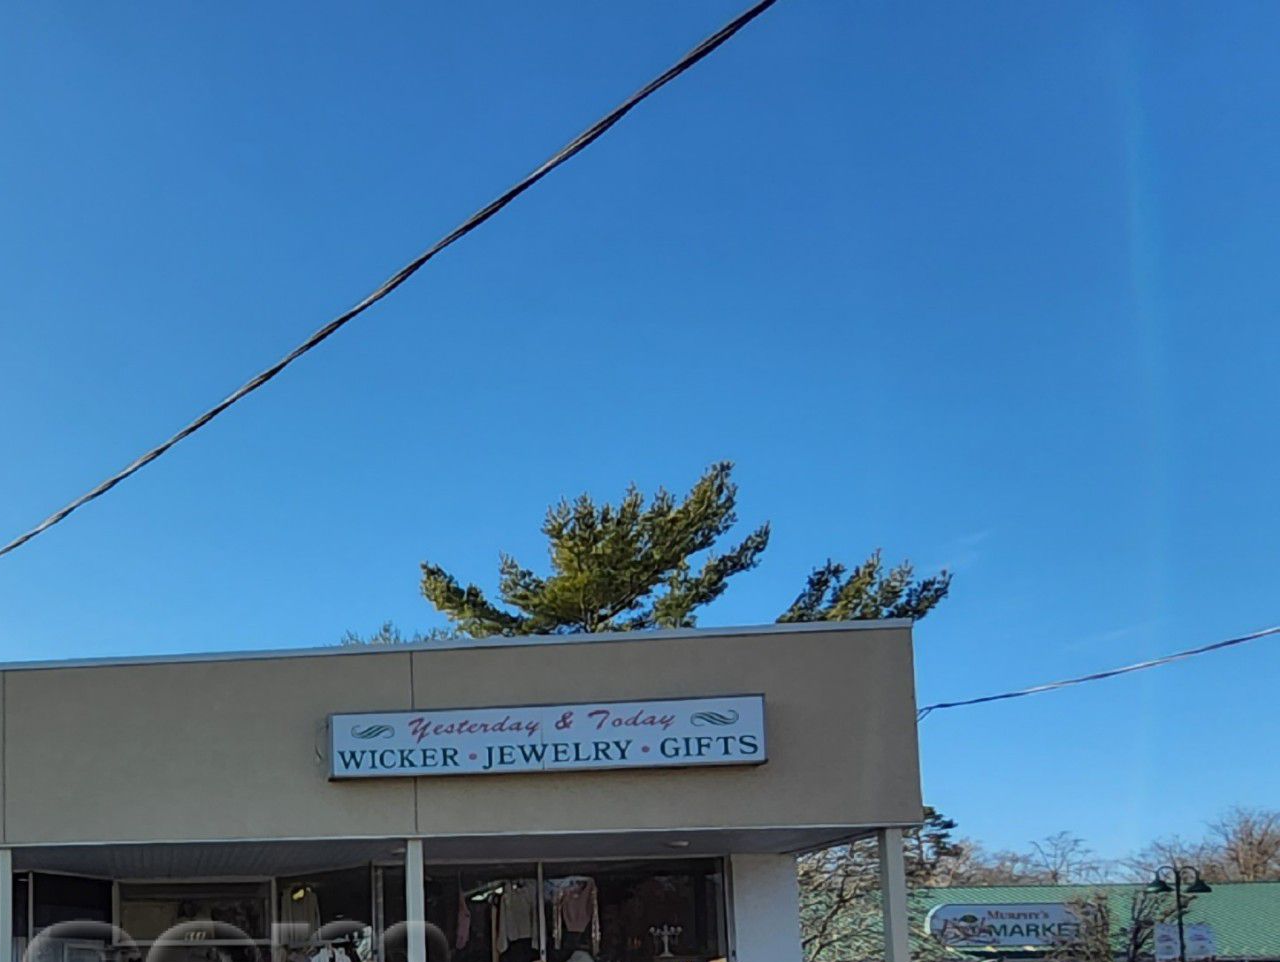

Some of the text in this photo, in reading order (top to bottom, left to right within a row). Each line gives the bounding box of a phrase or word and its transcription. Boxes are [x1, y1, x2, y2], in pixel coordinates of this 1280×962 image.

[408, 709, 675, 743] Yesterday & Today
[338, 735, 759, 770] WICKER JEWELRY GIFTS
